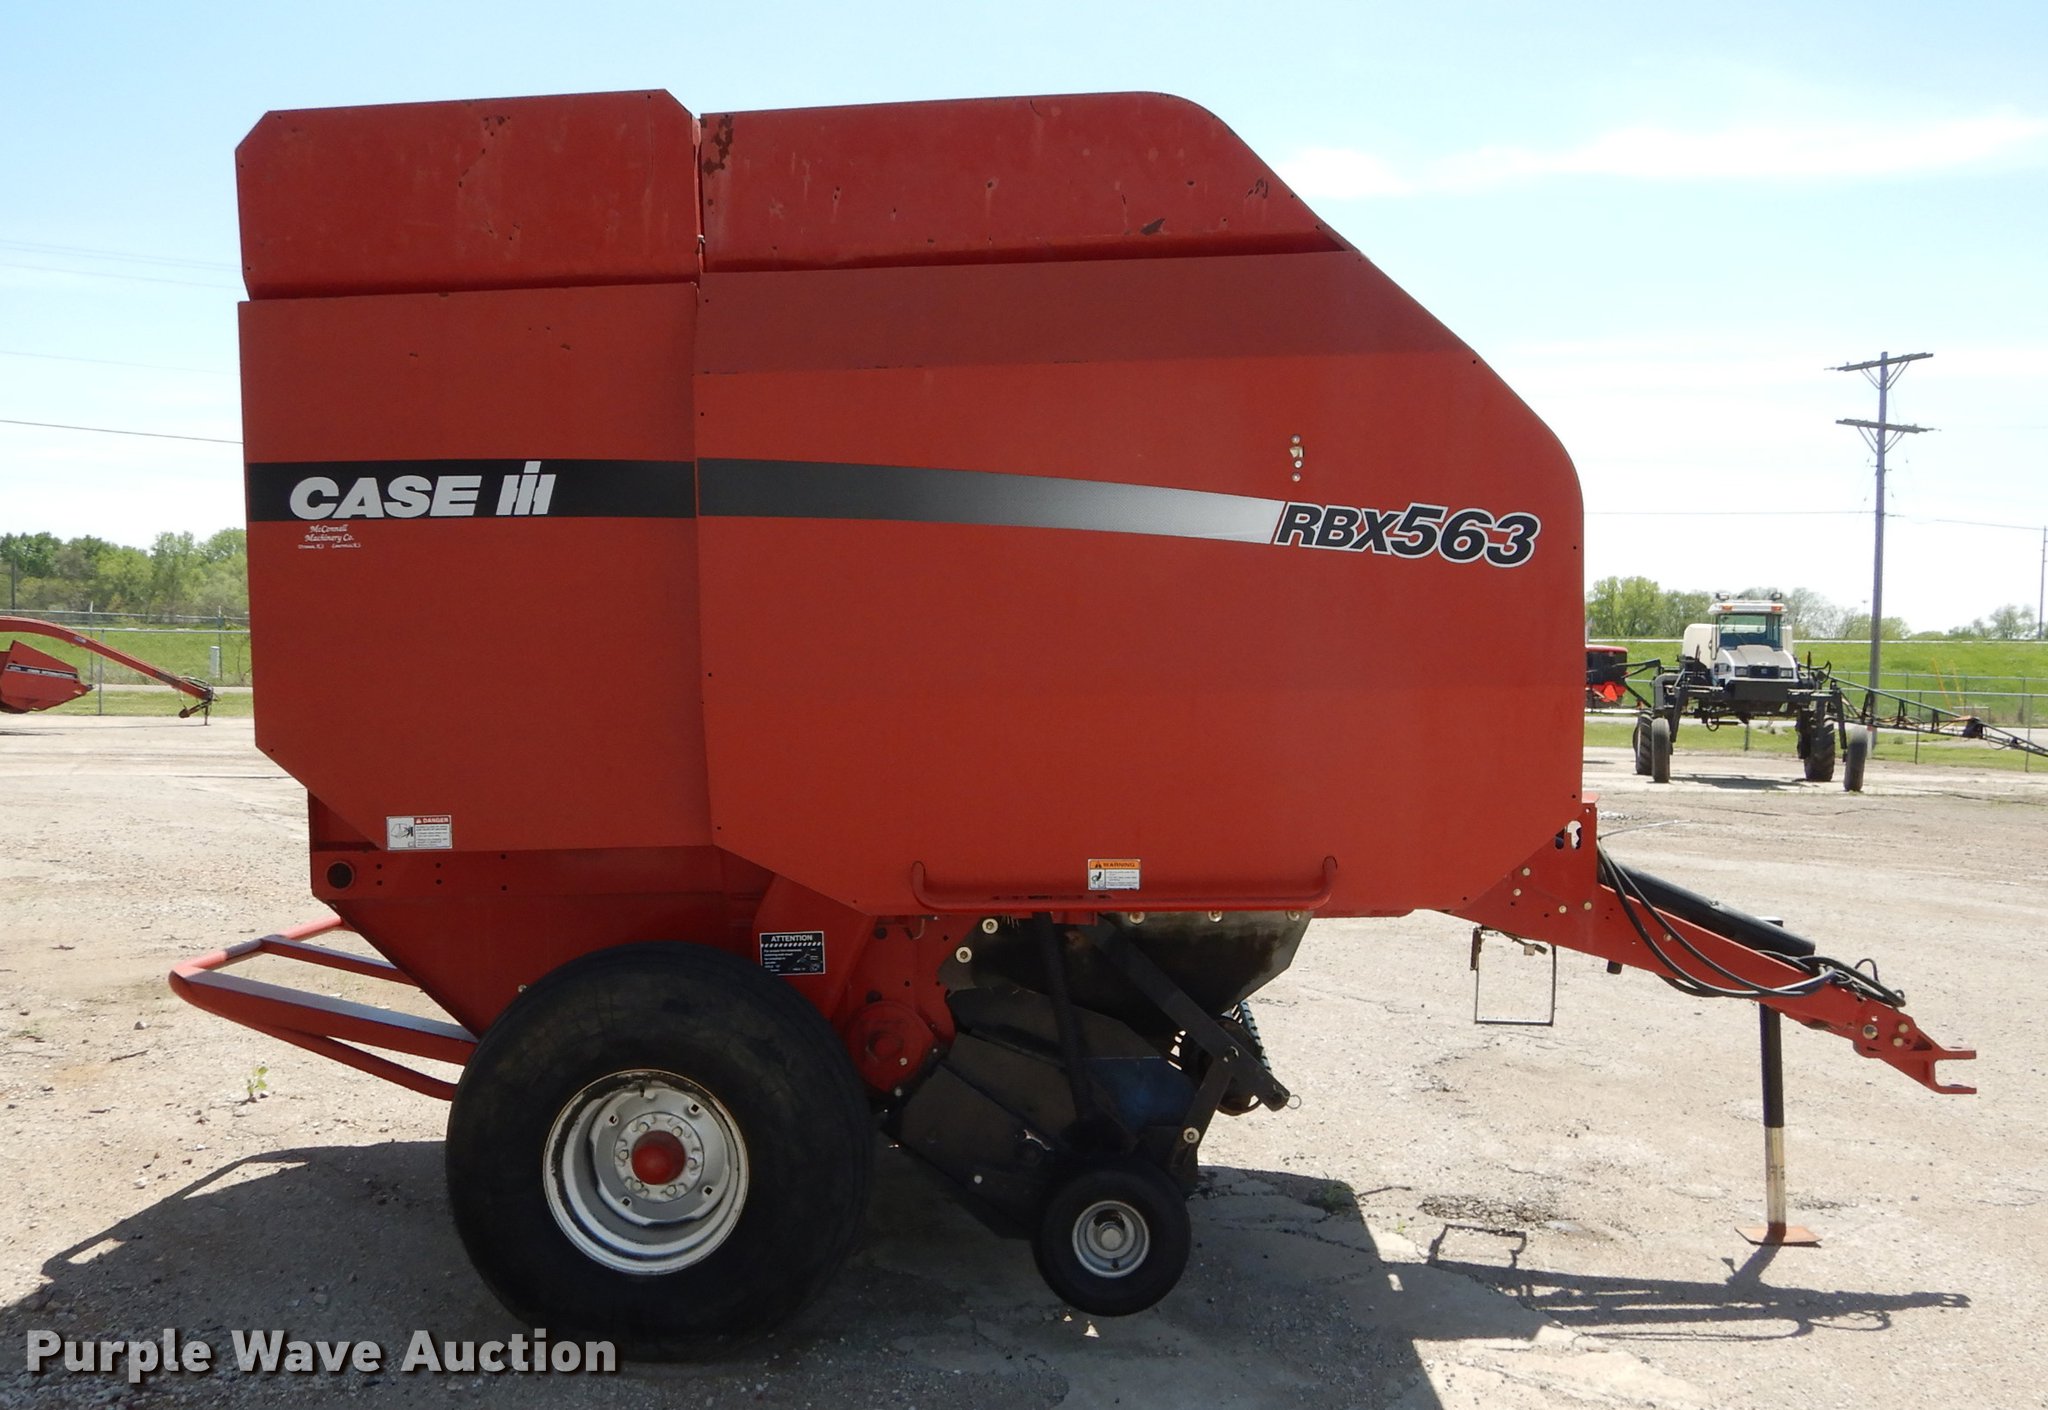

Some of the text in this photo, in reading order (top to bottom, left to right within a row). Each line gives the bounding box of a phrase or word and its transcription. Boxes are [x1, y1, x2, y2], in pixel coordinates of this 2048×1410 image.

[290, 475, 482, 520] CASE
[304, 534, 342, 543] Machinery
[310, 524, 348, 533] McConnell
[1275, 502, 1541, 567] RBX563
